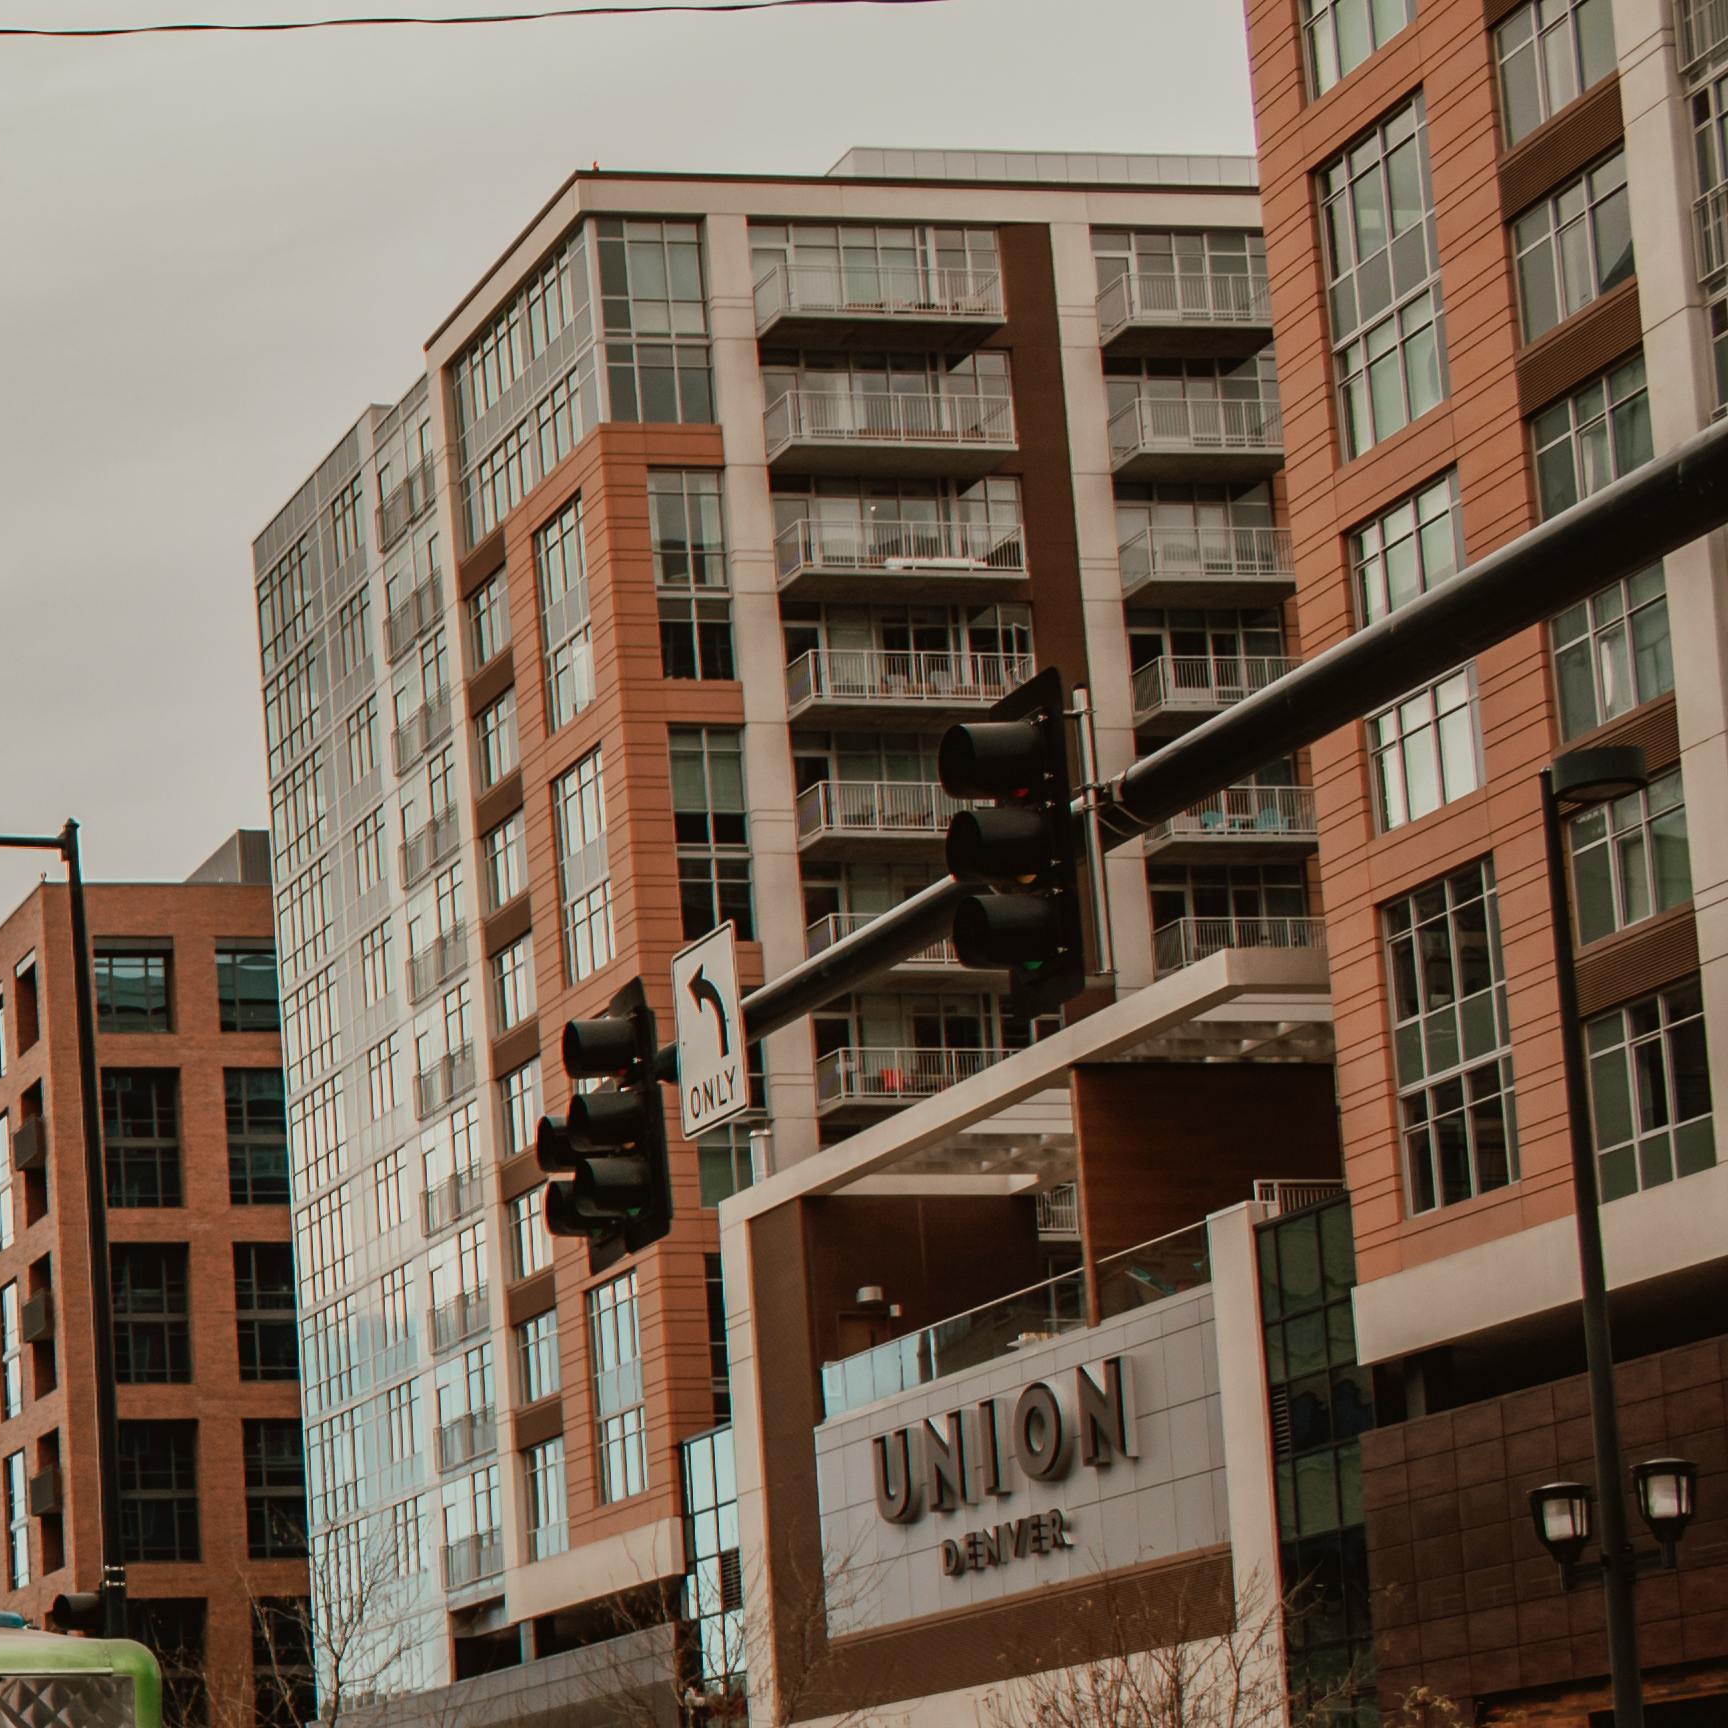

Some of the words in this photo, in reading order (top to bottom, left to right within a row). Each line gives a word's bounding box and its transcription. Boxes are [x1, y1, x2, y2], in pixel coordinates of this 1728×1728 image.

[690, 1066, 735, 1120] ONLY
[872, 1355, 1139, 1524] UNION
[942, 1508, 1074, 1576] DENVER
